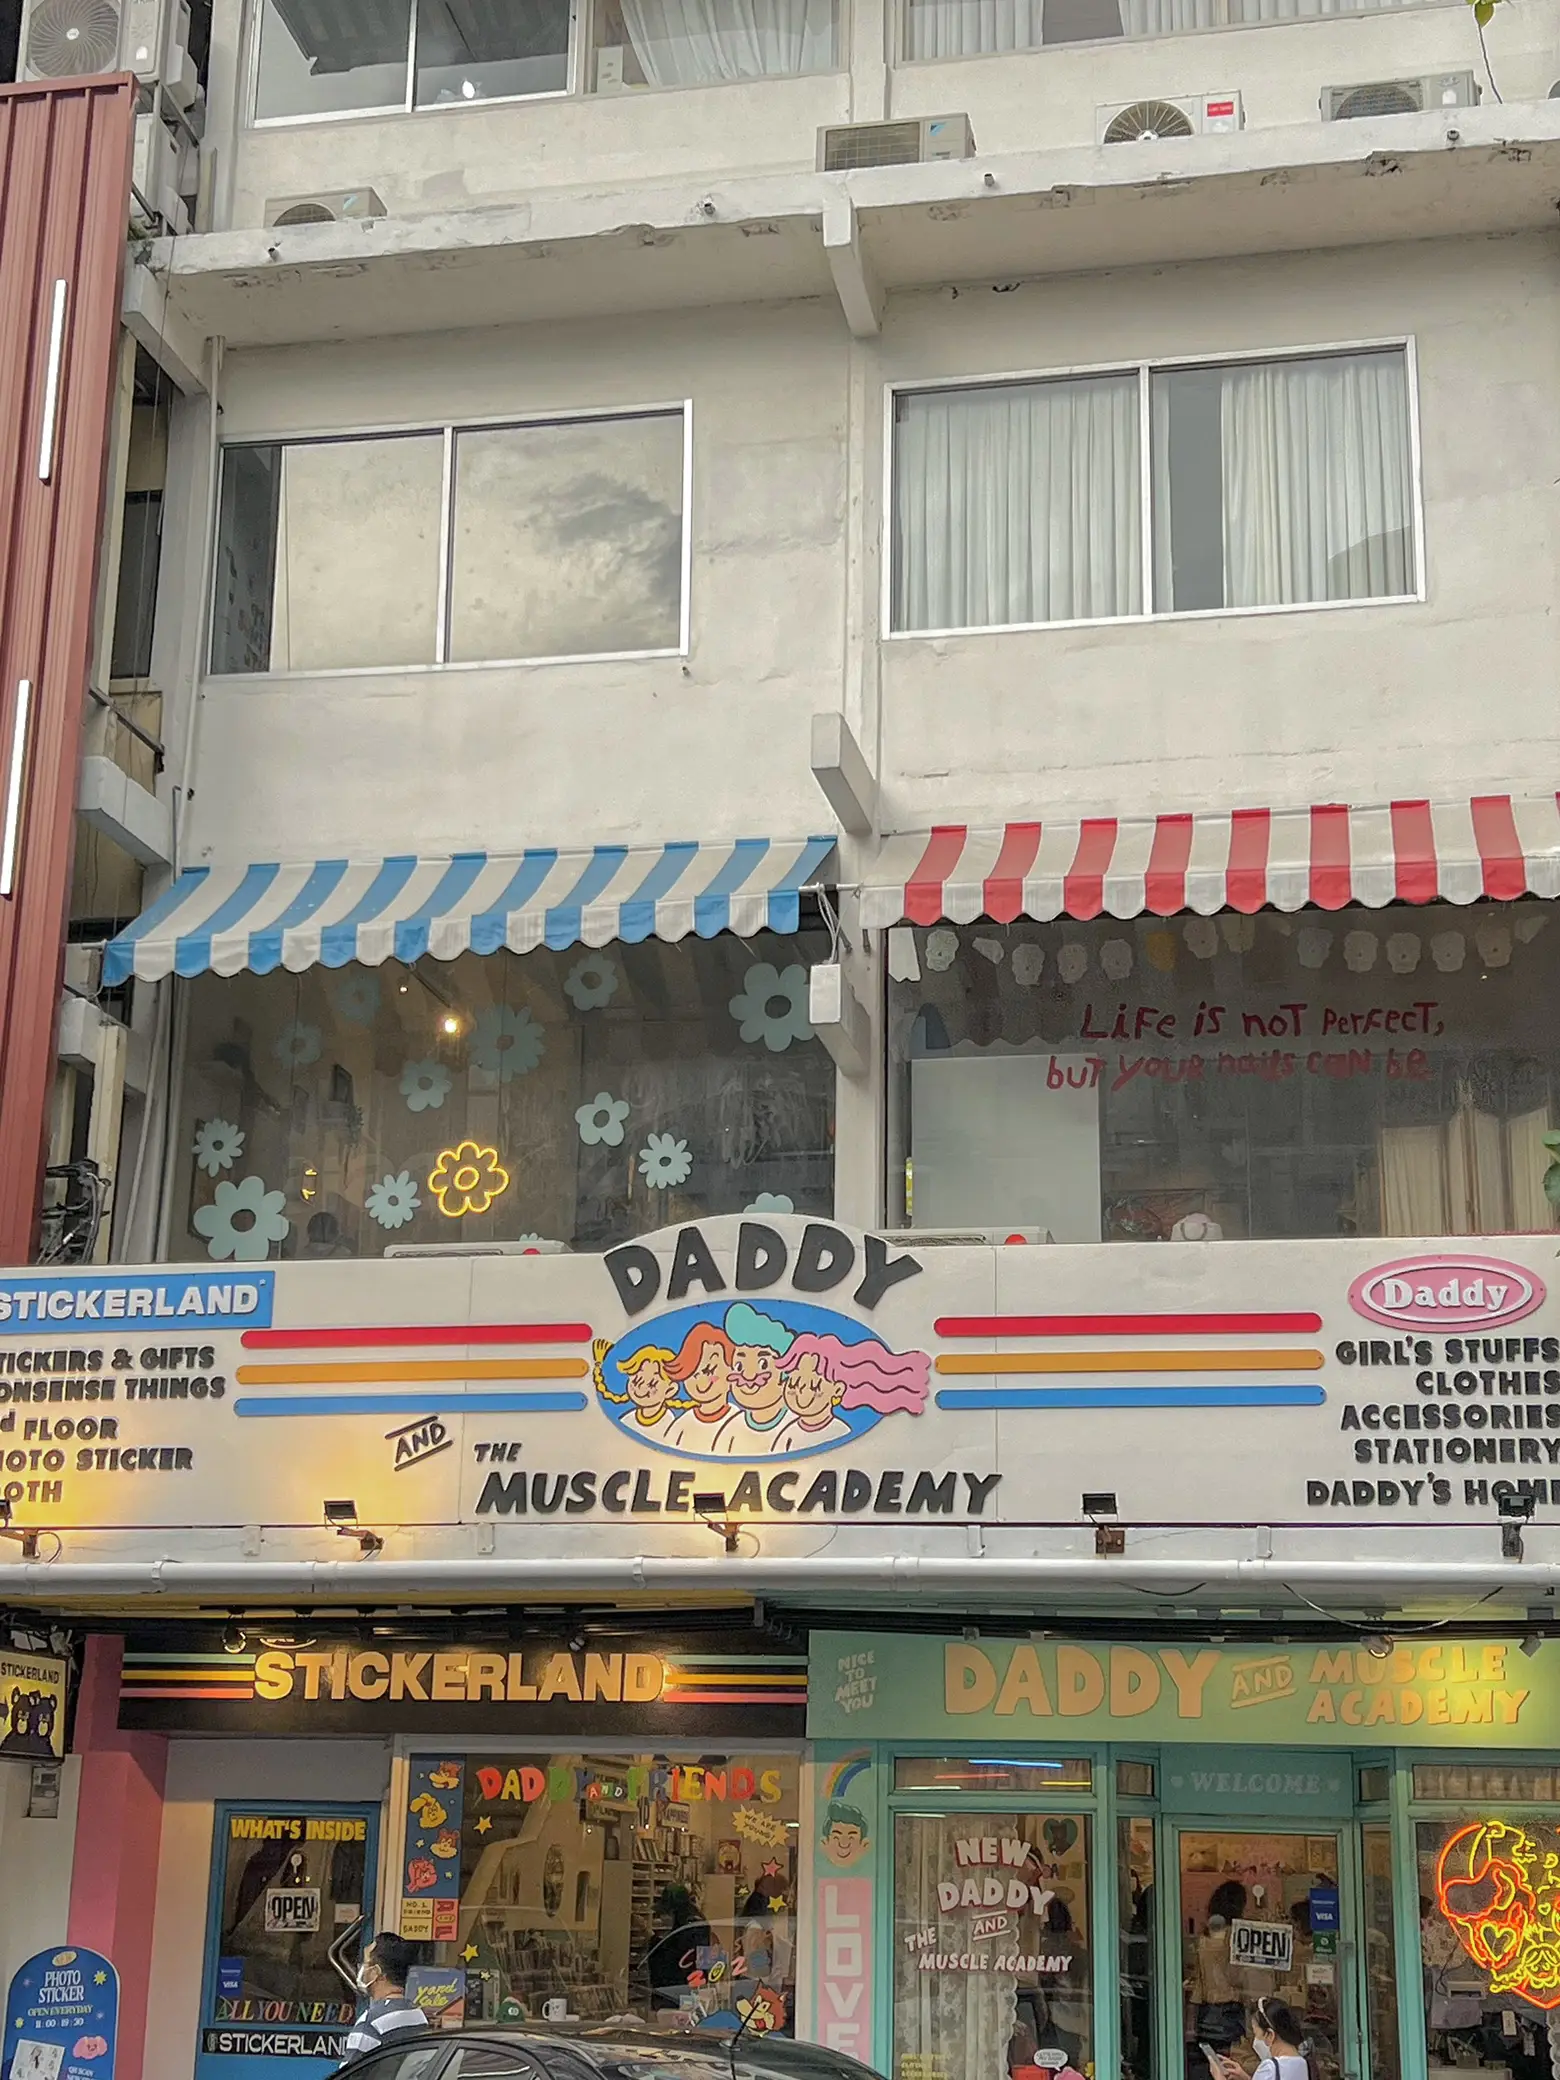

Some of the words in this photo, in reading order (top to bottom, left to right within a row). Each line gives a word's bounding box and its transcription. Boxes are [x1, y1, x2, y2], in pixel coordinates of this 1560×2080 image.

[1193, 1001, 1226, 1037] is
[603, 1222, 923, 1316] DADDY
[1382, 1278, 1508, 1312] Daddy
[111, 1348, 134, 1370] &
[140, 1346, 216, 1370] GIFTS
[1335, 1335, 1433, 1367] GIRL'S
[1445, 1336, 1560, 1364] STUFFS
[124, 1375, 227, 1400] THINGS
[1416, 1369, 1560, 1396] CLOTHES
[23, 1417, 119, 1441] FLOOR
[1340, 1403, 1560, 1431] ACCESSORIES
[396, 1421, 447, 1464] AND
[474, 1441, 521, 1465] THE
[1354, 1436, 1560, 1465] STATIONERY
[0, 1448, 65, 1473] OTO
[76, 1447, 194, 1472] STICKER
[475, 1469, 696, 1515] MUSCLE
[728, 1469, 1003, 1515] ACADEMY
[1306, 1472, 1452, 1506] DADDY'S
[1, 1661, 60, 1685] STICKERLAND
[838, 1650, 875, 1672] NICE
[1308, 1646, 1508, 1685] MUSCLE
[254, 1650, 663, 1702] STICKERLAND
[845, 1667, 865, 1682] TO
[944, 1641, 1222, 1719] DADDY
[1231, 1664, 1294, 1701] AND
[835, 1676, 877, 1702] MEET
[840, 1694, 874, 1713] YOU
[1305, 1689, 1531, 1727] ACADEMY
[628, 1766, 782, 1803] FRIENDS
[1191, 1771, 1321, 1794] WELCOME
[231, 1818, 302, 1840] WHAT'S
[306, 1820, 366, 1841] INSIDE
[955, 1837, 1031, 1868] NEW
[271, 1896, 315, 1920] OPEN
[937, 1877, 1055, 1916] DADDY
[973, 1916, 1008, 1936] AND
[1315, 1912, 1334, 1921] VISA
[905, 1927, 937, 1952] THE
[1237, 1927, 1287, 1958] OPEN
[919, 1953, 989, 1971] MUSCLE
[993, 1955, 1073, 1972] ACADEMY
[44, 1970, 81, 1988] PHOTO
[222, 1981, 238, 1989] VISA
[38, 1985, 85, 2004] STICKER
[215, 2000, 254, 2022] ALL
[255, 2000, 294, 2022] YOU
[296, 2000, 356, 2024] NEED
